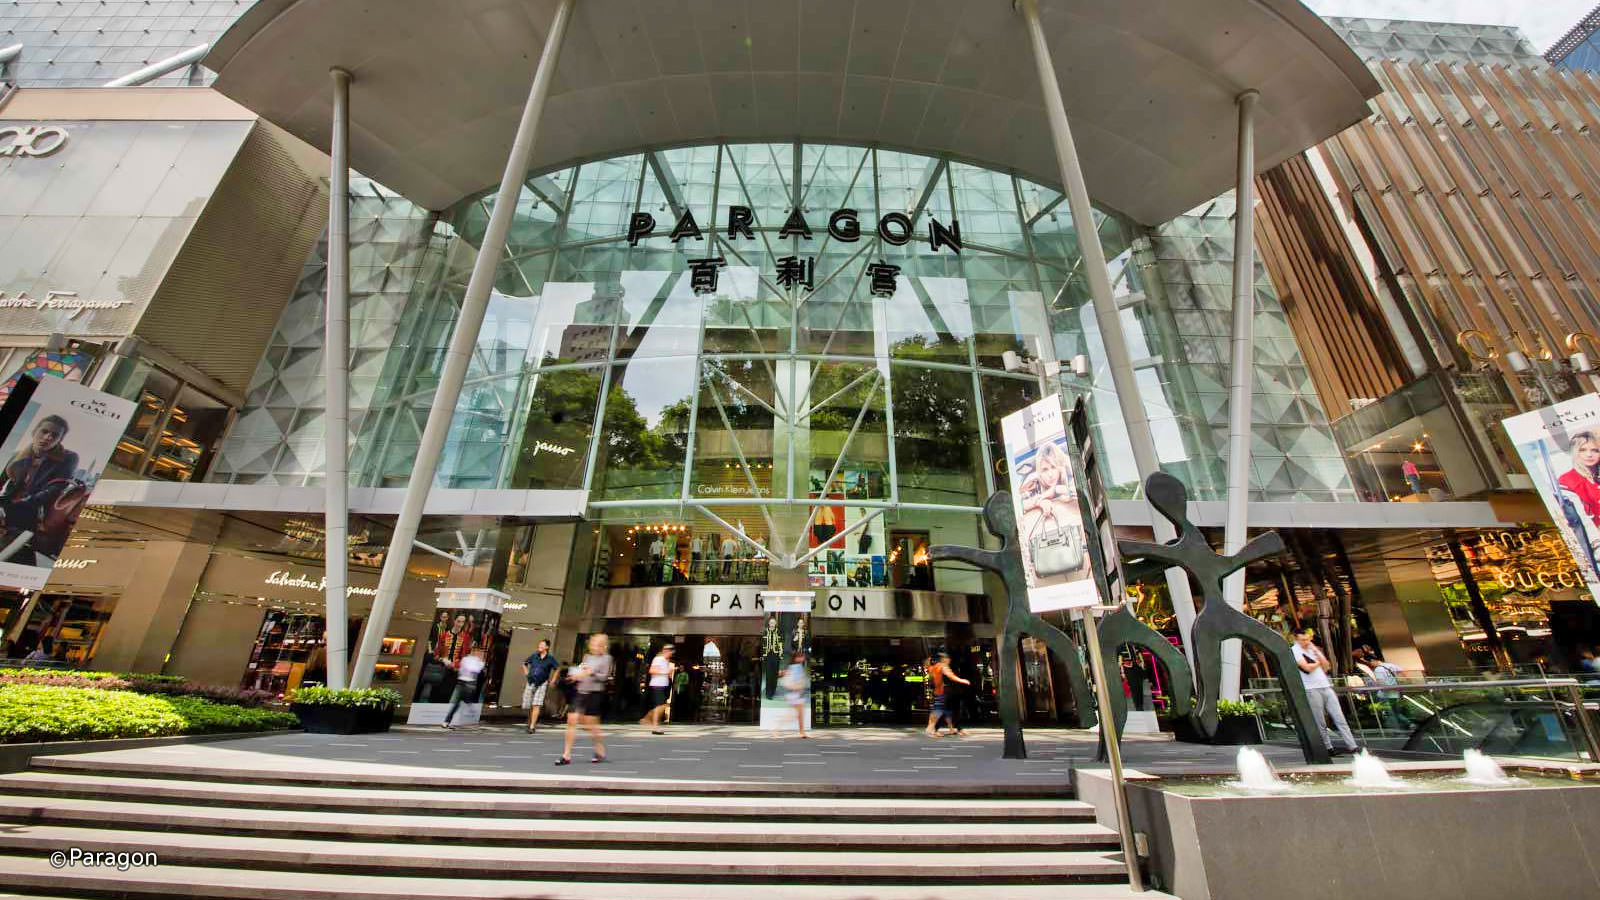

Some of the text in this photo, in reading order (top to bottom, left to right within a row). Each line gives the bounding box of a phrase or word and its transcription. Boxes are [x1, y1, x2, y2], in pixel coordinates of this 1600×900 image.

[627, 205, 963, 255] PARAGON
[697, 484, 723, 495] Calvin
[265, 571, 318, 589] Salvatore
[1499, 572, 1584, 588] GUCCI
[710, 593, 866, 611] PARON
